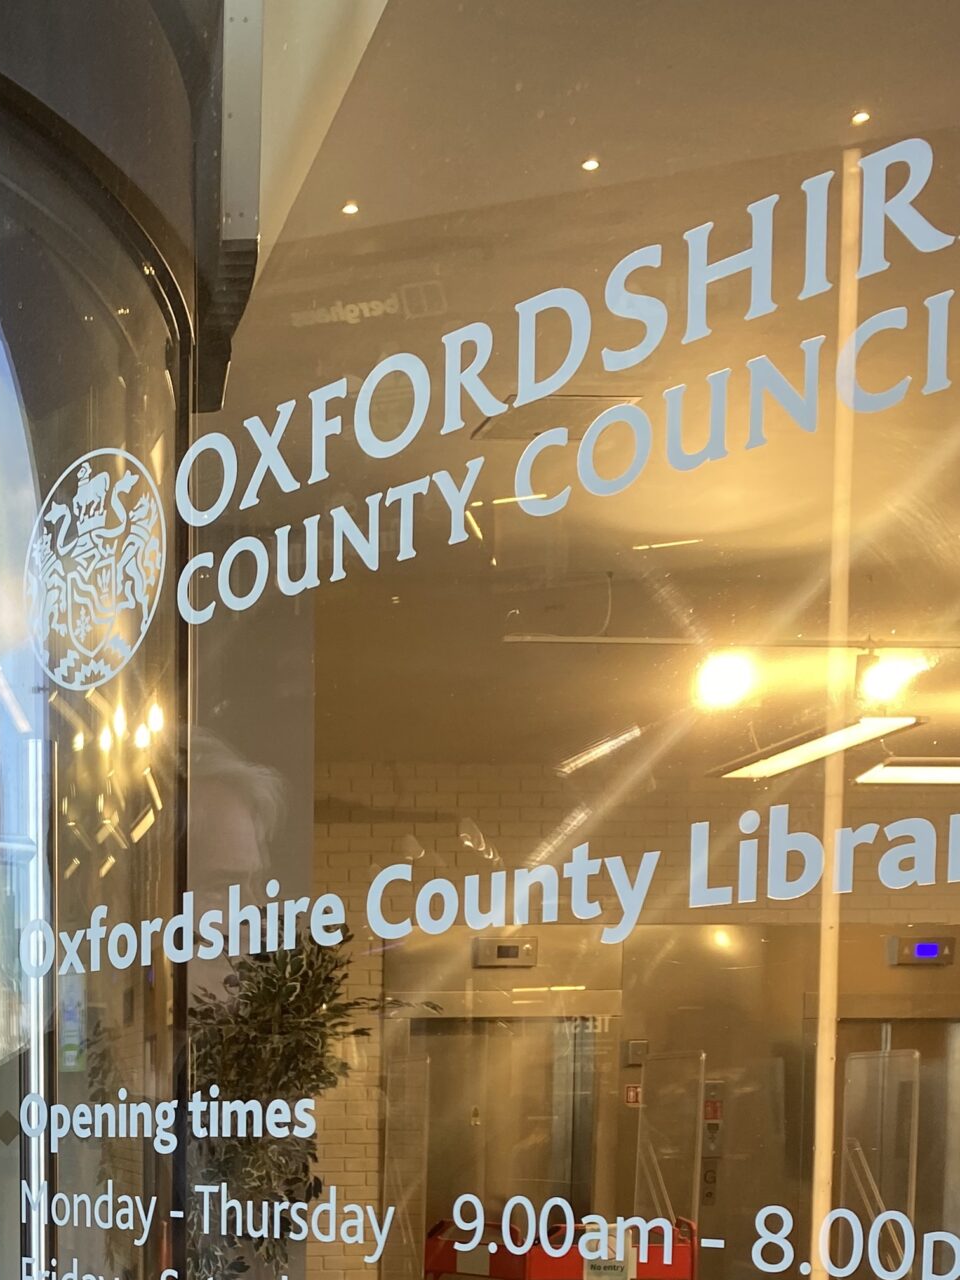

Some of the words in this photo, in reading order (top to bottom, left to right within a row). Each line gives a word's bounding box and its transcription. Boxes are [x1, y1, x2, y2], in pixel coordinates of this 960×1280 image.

[175, 137, 960, 527] OXFORDSHIR
[177, 456, 485, 625] COUNTY
[514, 289, 956, 517] COUNCI
[19, 878, 346, 979] Oxfordshire
[366, 841, 661, 944] County
[20, 1087, 179, 1155] Opening
[188, 1084, 317, 1139] times
[21, 1179, 157, 1247] Monday
[170, 1210, 184, 1218] -
[194, 1182, 396, 1264] Thursday
[452, 1193, 673, 1265] 9.00am
[701, 1238, 725, 1249] -
[590, 1263, 602, 1271] No
[603, 1263, 625, 1273] entry
